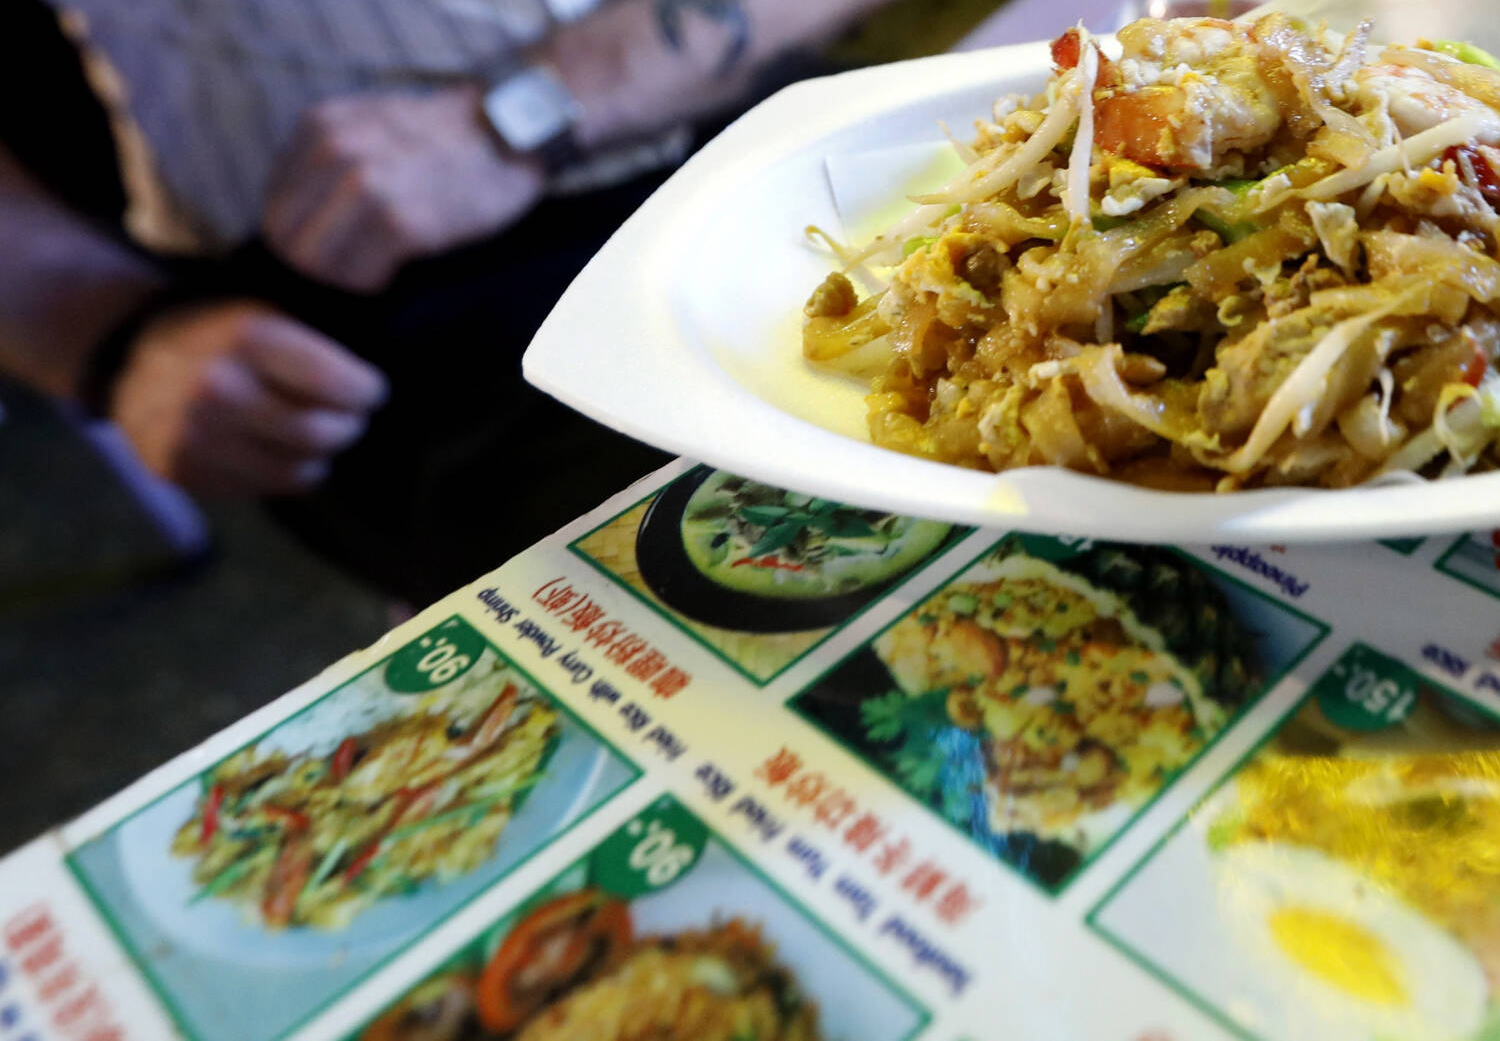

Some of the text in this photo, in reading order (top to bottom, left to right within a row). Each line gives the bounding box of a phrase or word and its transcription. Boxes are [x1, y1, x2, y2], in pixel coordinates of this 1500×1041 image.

[476, 586, 521, 624] Shrimp
[513, 618, 562, 659] Powder
[556, 649, 595, 685] Curry
[588, 676, 623, 707] with
[618, 701, 653, 734] Rice
